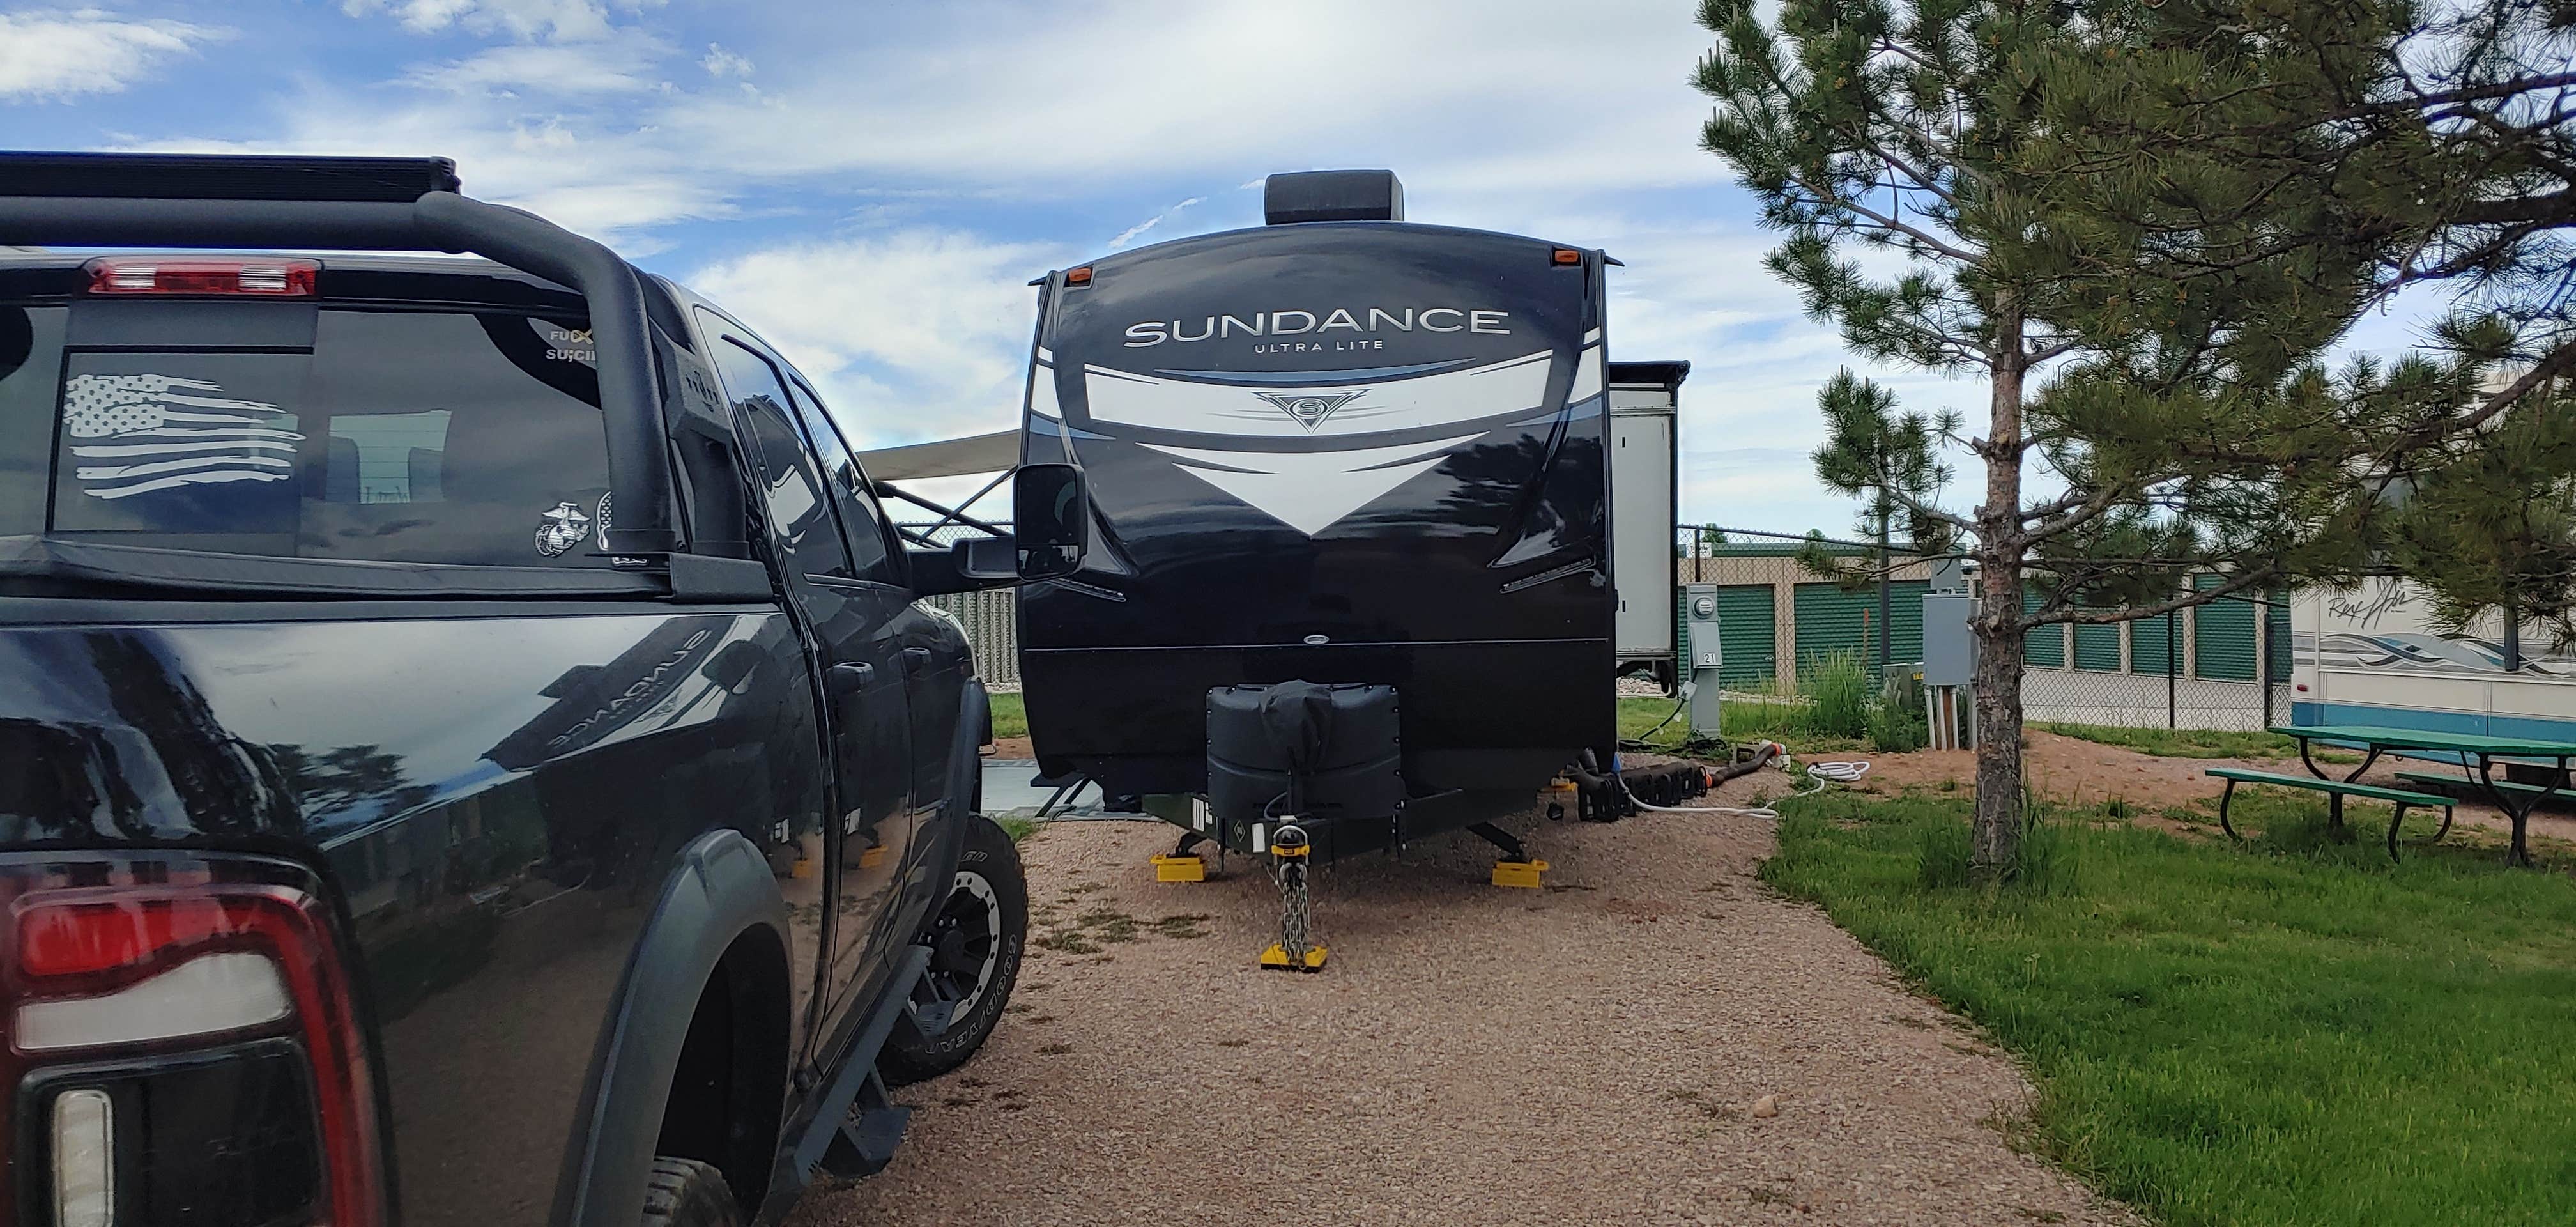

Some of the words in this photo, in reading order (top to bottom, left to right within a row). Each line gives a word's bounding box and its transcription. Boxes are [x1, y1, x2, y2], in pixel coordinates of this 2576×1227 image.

[1123, 308, 1510, 348] SUNDANCE
[1255, 343, 1322, 353] ULTRA
[1336, 340, 1383, 350] LITE
[1704, 654, 1715, 663] 21
